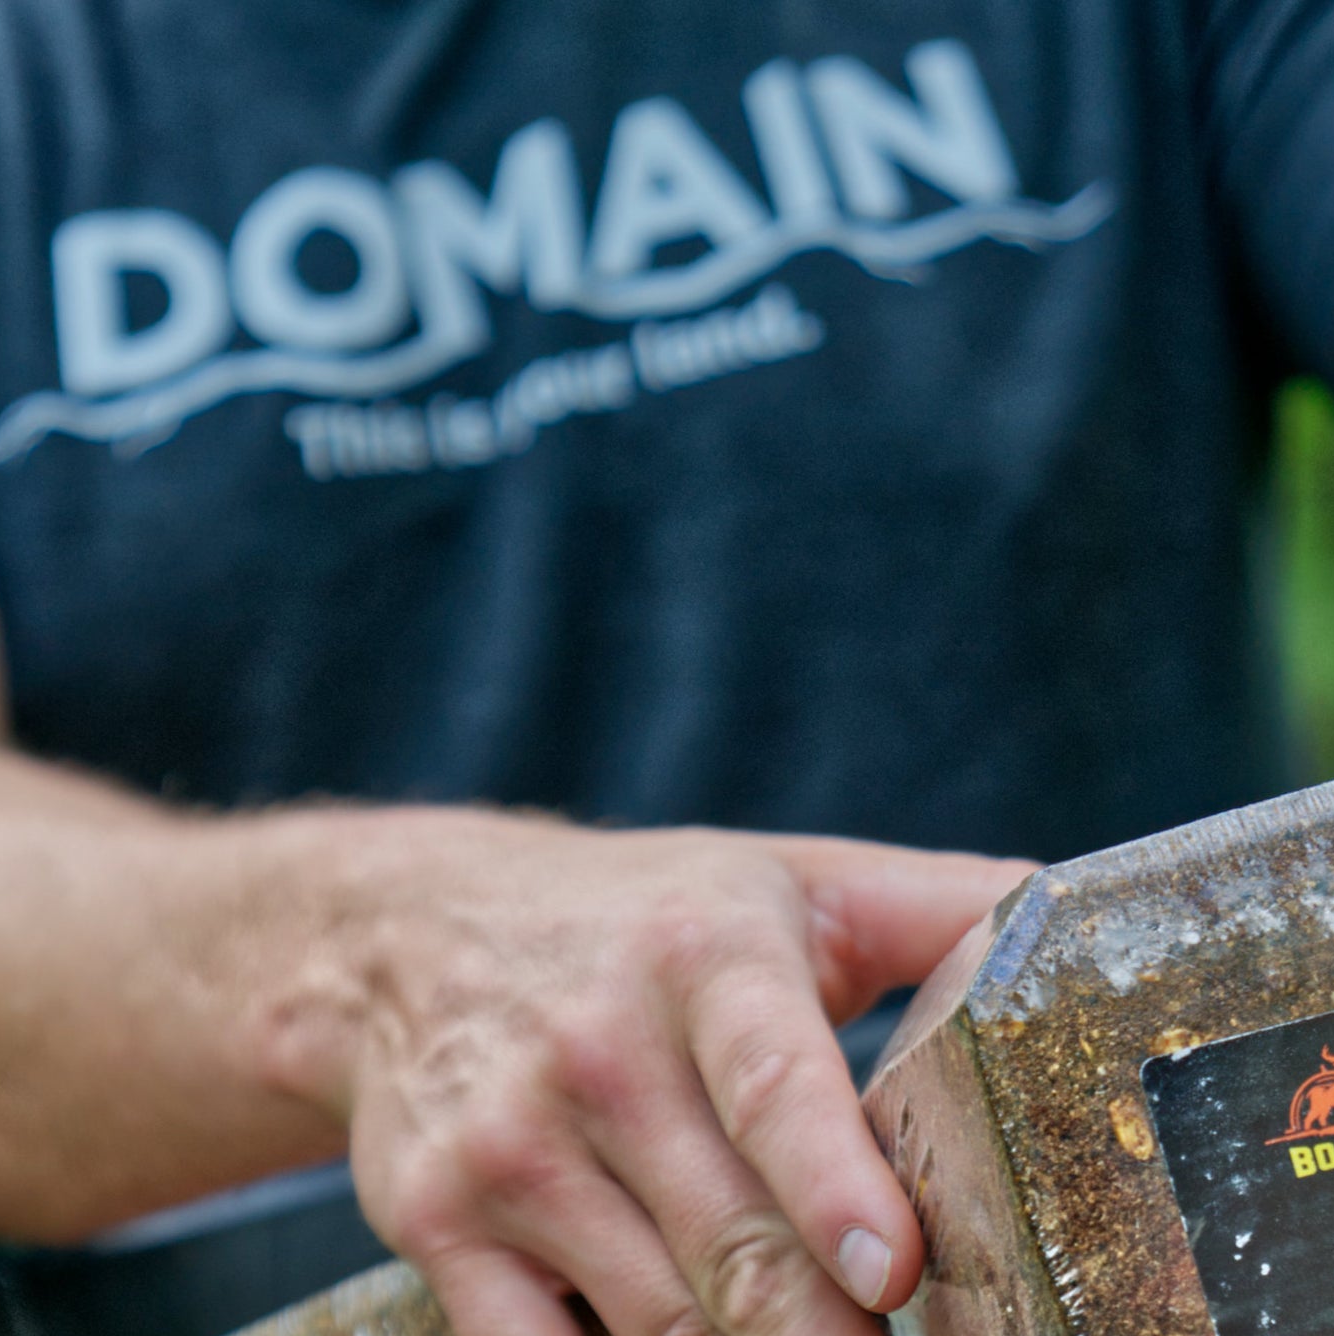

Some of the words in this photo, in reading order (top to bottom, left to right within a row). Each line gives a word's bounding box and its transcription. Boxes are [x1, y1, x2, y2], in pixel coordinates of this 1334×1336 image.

[51, 36, 1017, 396] DOMAIN
[287, 404, 431, 480] This
[431, 395, 494, 468] is
[633, 284, 825, 390] land.
